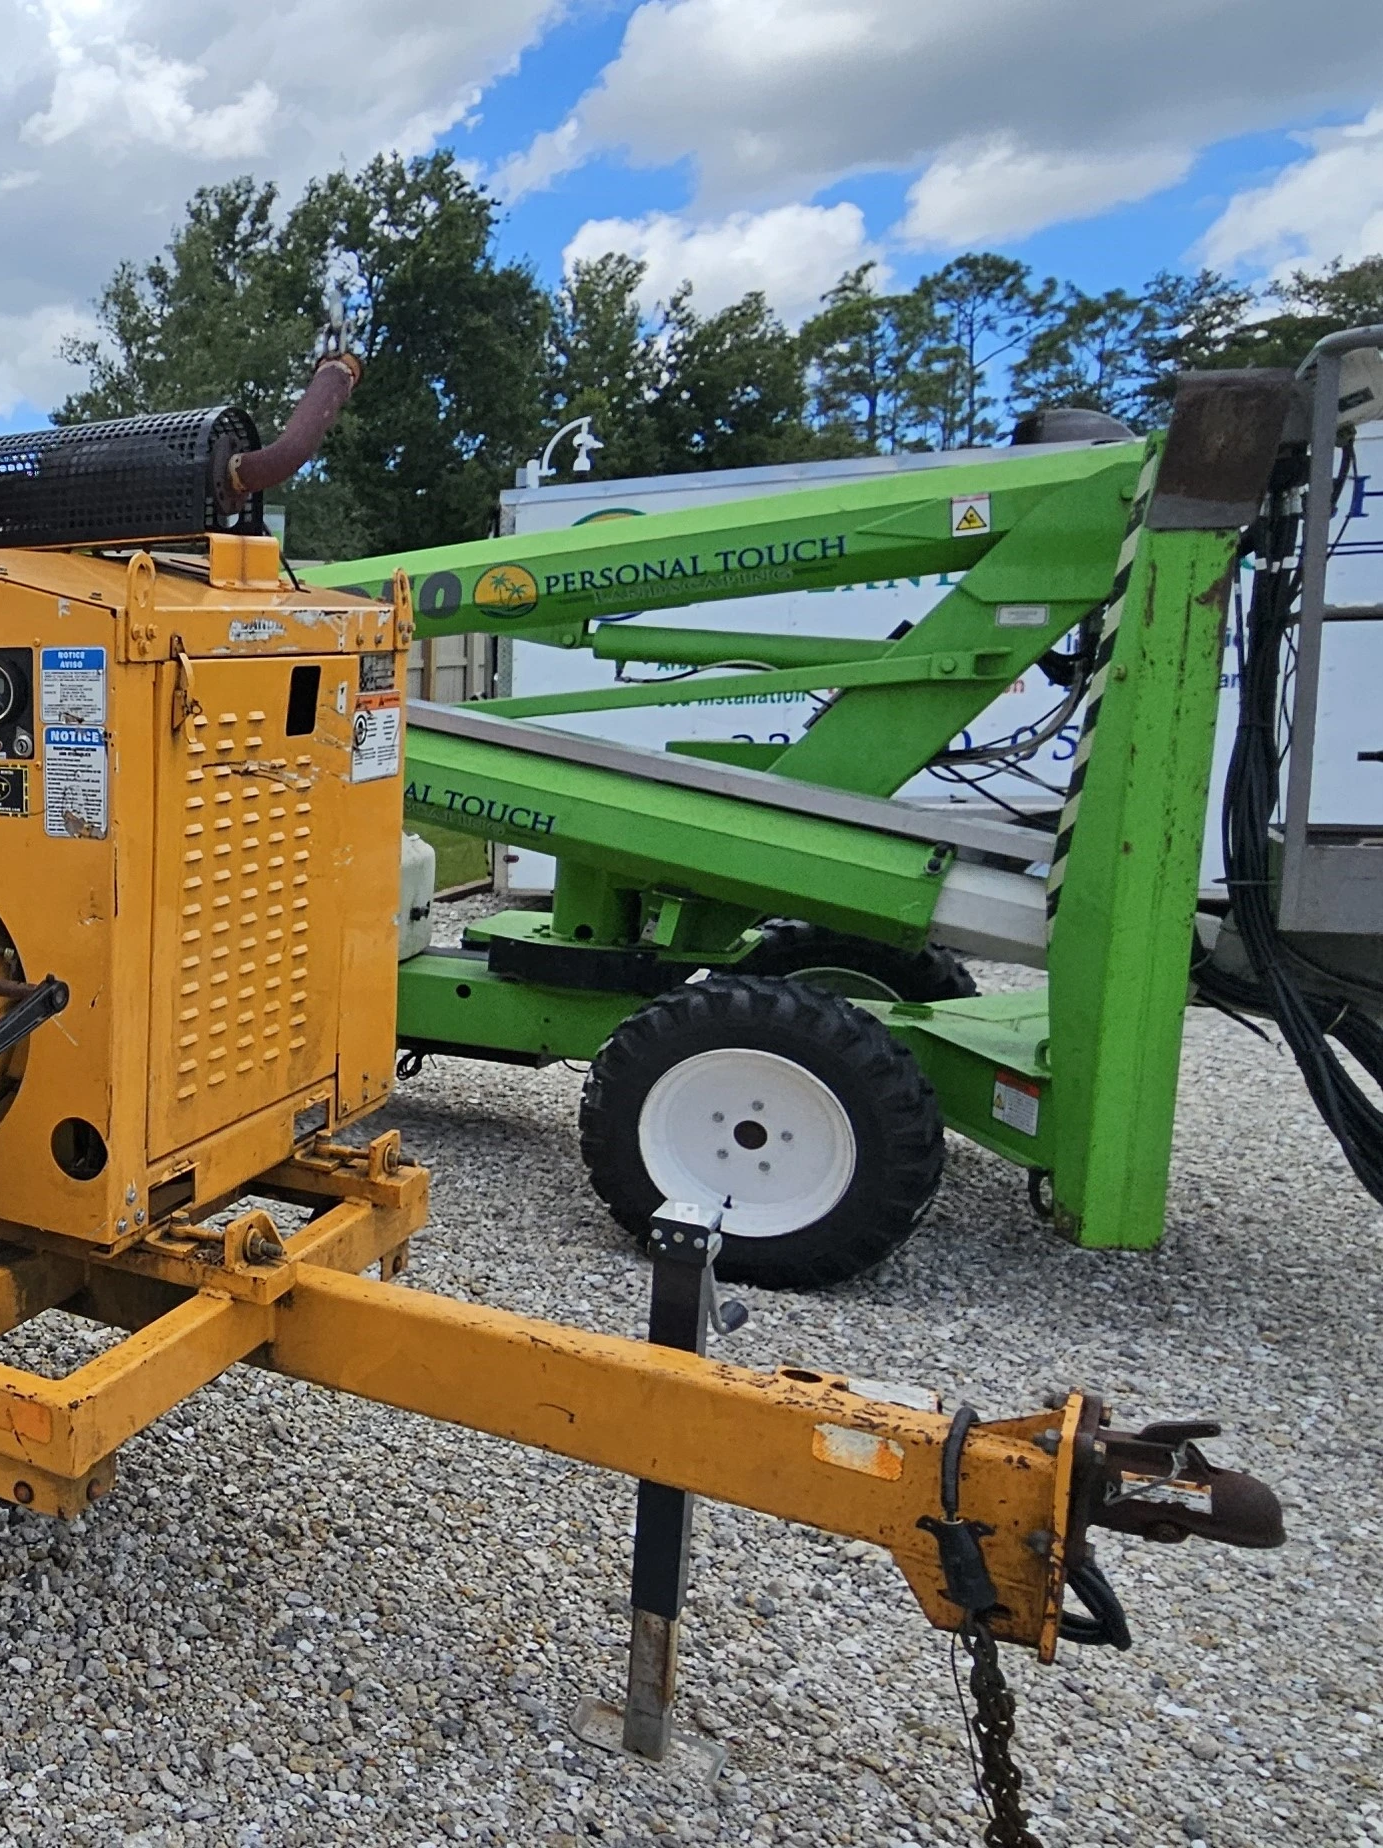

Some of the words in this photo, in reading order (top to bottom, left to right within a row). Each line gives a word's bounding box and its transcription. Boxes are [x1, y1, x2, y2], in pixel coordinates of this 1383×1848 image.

[544, 554, 706, 596] PERSONAL
[715, 534, 846, 572] TOUCH
[58, 651, 85, 659] NOTICE
[60, 660, 83, 668] AVISO
[50, 730, 99, 743] NOTICE
[444, 789, 557, 835] TOUCH
